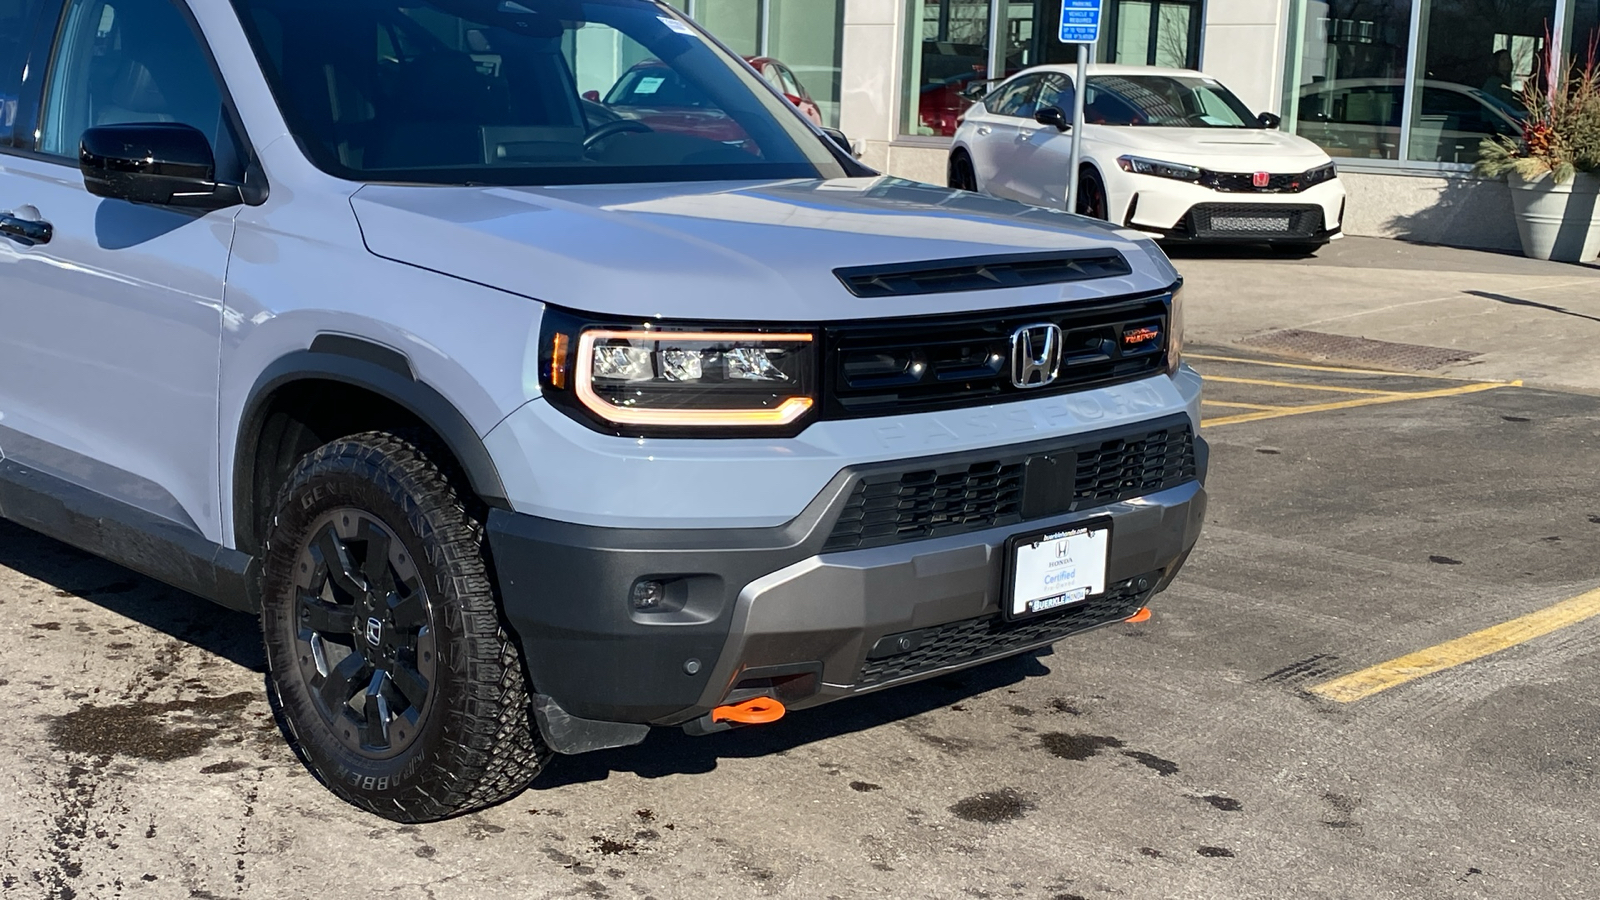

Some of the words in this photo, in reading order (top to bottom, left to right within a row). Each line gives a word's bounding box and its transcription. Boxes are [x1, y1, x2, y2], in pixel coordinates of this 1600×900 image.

[872, 385, 1165, 449] PASSPORT
[1048, 557, 1074, 568] HONDA
[1044, 568, 1076, 585] Certified
